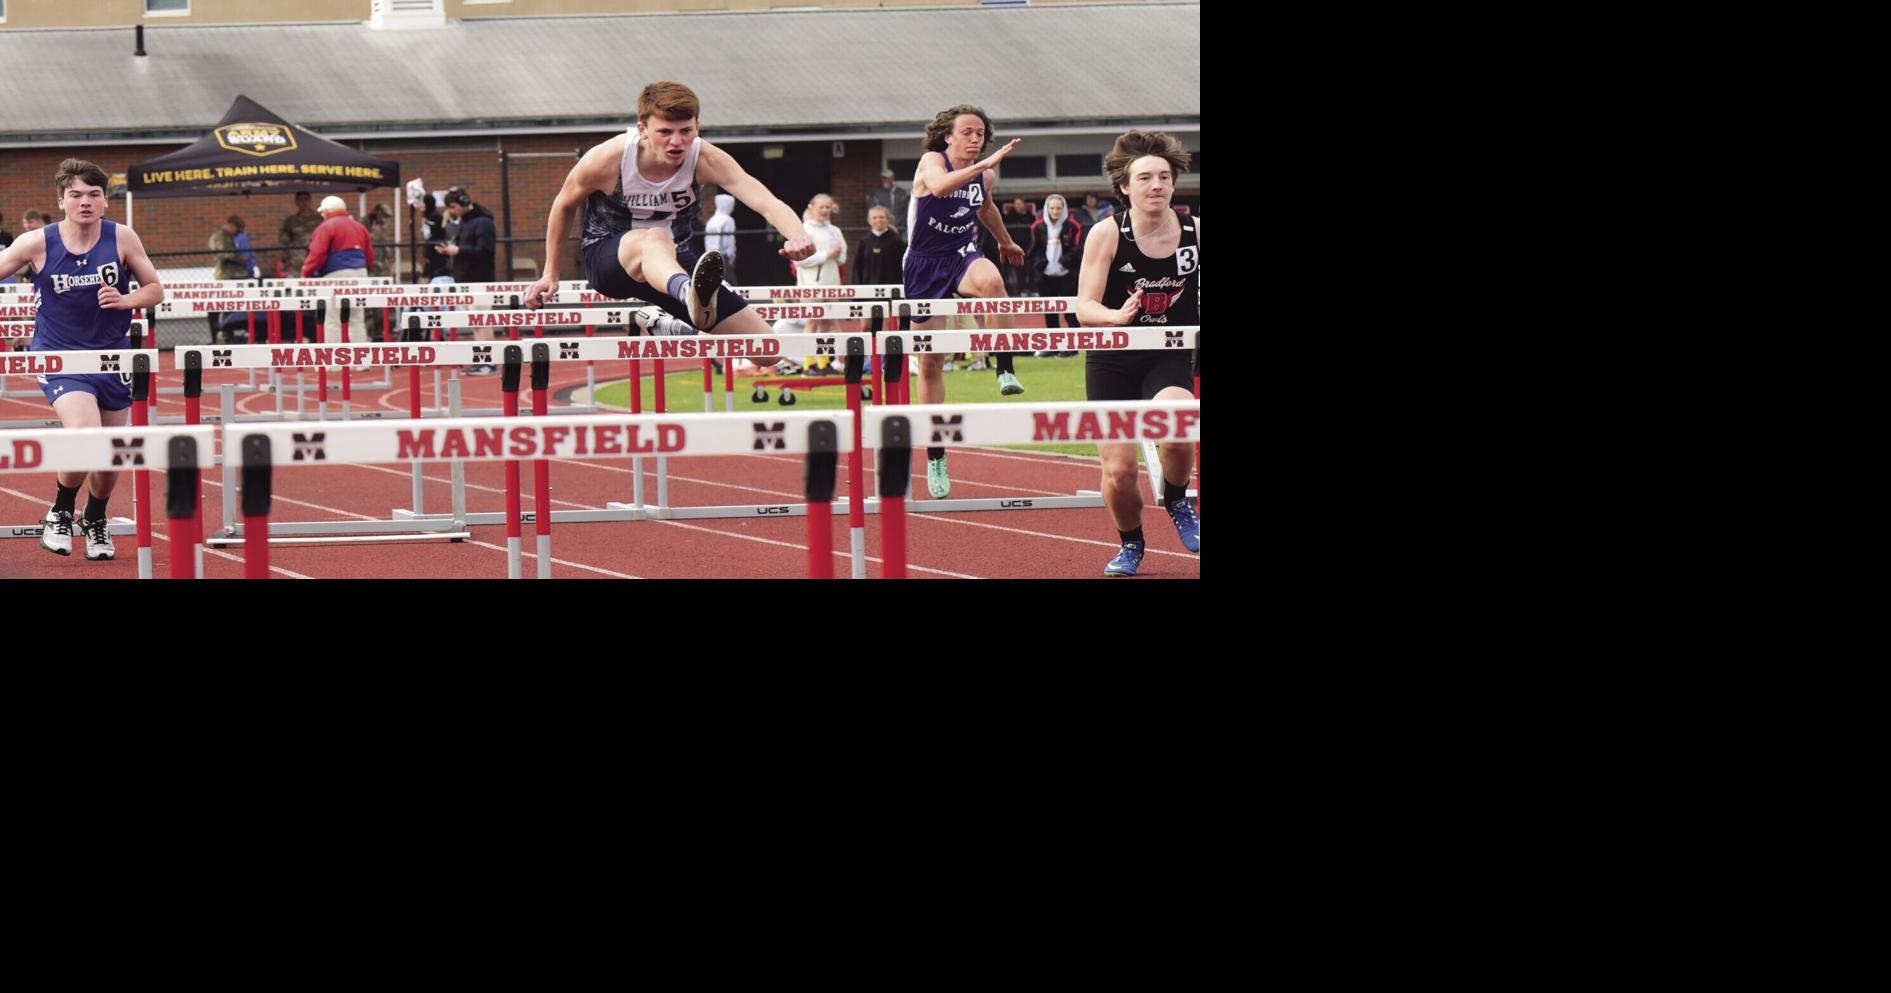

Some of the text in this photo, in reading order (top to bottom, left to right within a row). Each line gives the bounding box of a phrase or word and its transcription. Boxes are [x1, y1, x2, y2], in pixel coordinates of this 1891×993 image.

[143, 164, 384, 184] LIVE HERE. TRAIN HERE. SERVE HERE.
[671, 190, 692, 209] 5
[970, 186, 981, 204] 2
[1180, 248, 1196, 273] 3
[101, 265, 116, 286] 6
[1134, 276, 1187, 290] Bradford
[173, 290, 244, 299] MANSFIELD
[333, 287, 404, 296] MANSFIELD
[770, 288, 855, 299] MANSFIELD
[192, 300, 280, 312] MANSFIELD
[387, 296, 474, 306] MANSFIELD
[957, 301, 1068, 314] MANSFIELD
[468, 312, 582, 326] MANSFIELD
[1140, 314, 1168, 323] Owls
[618, 337, 780, 358] MANSFIELD
[970, 331, 1130, 352] MANSFIELD
[271, 346, 436, 366] MANSFIELD
[396, 423, 686, 458] MANSFIELD
[757, 506, 790, 514] UCS
[1000, 500, 1033, 508] UCS
